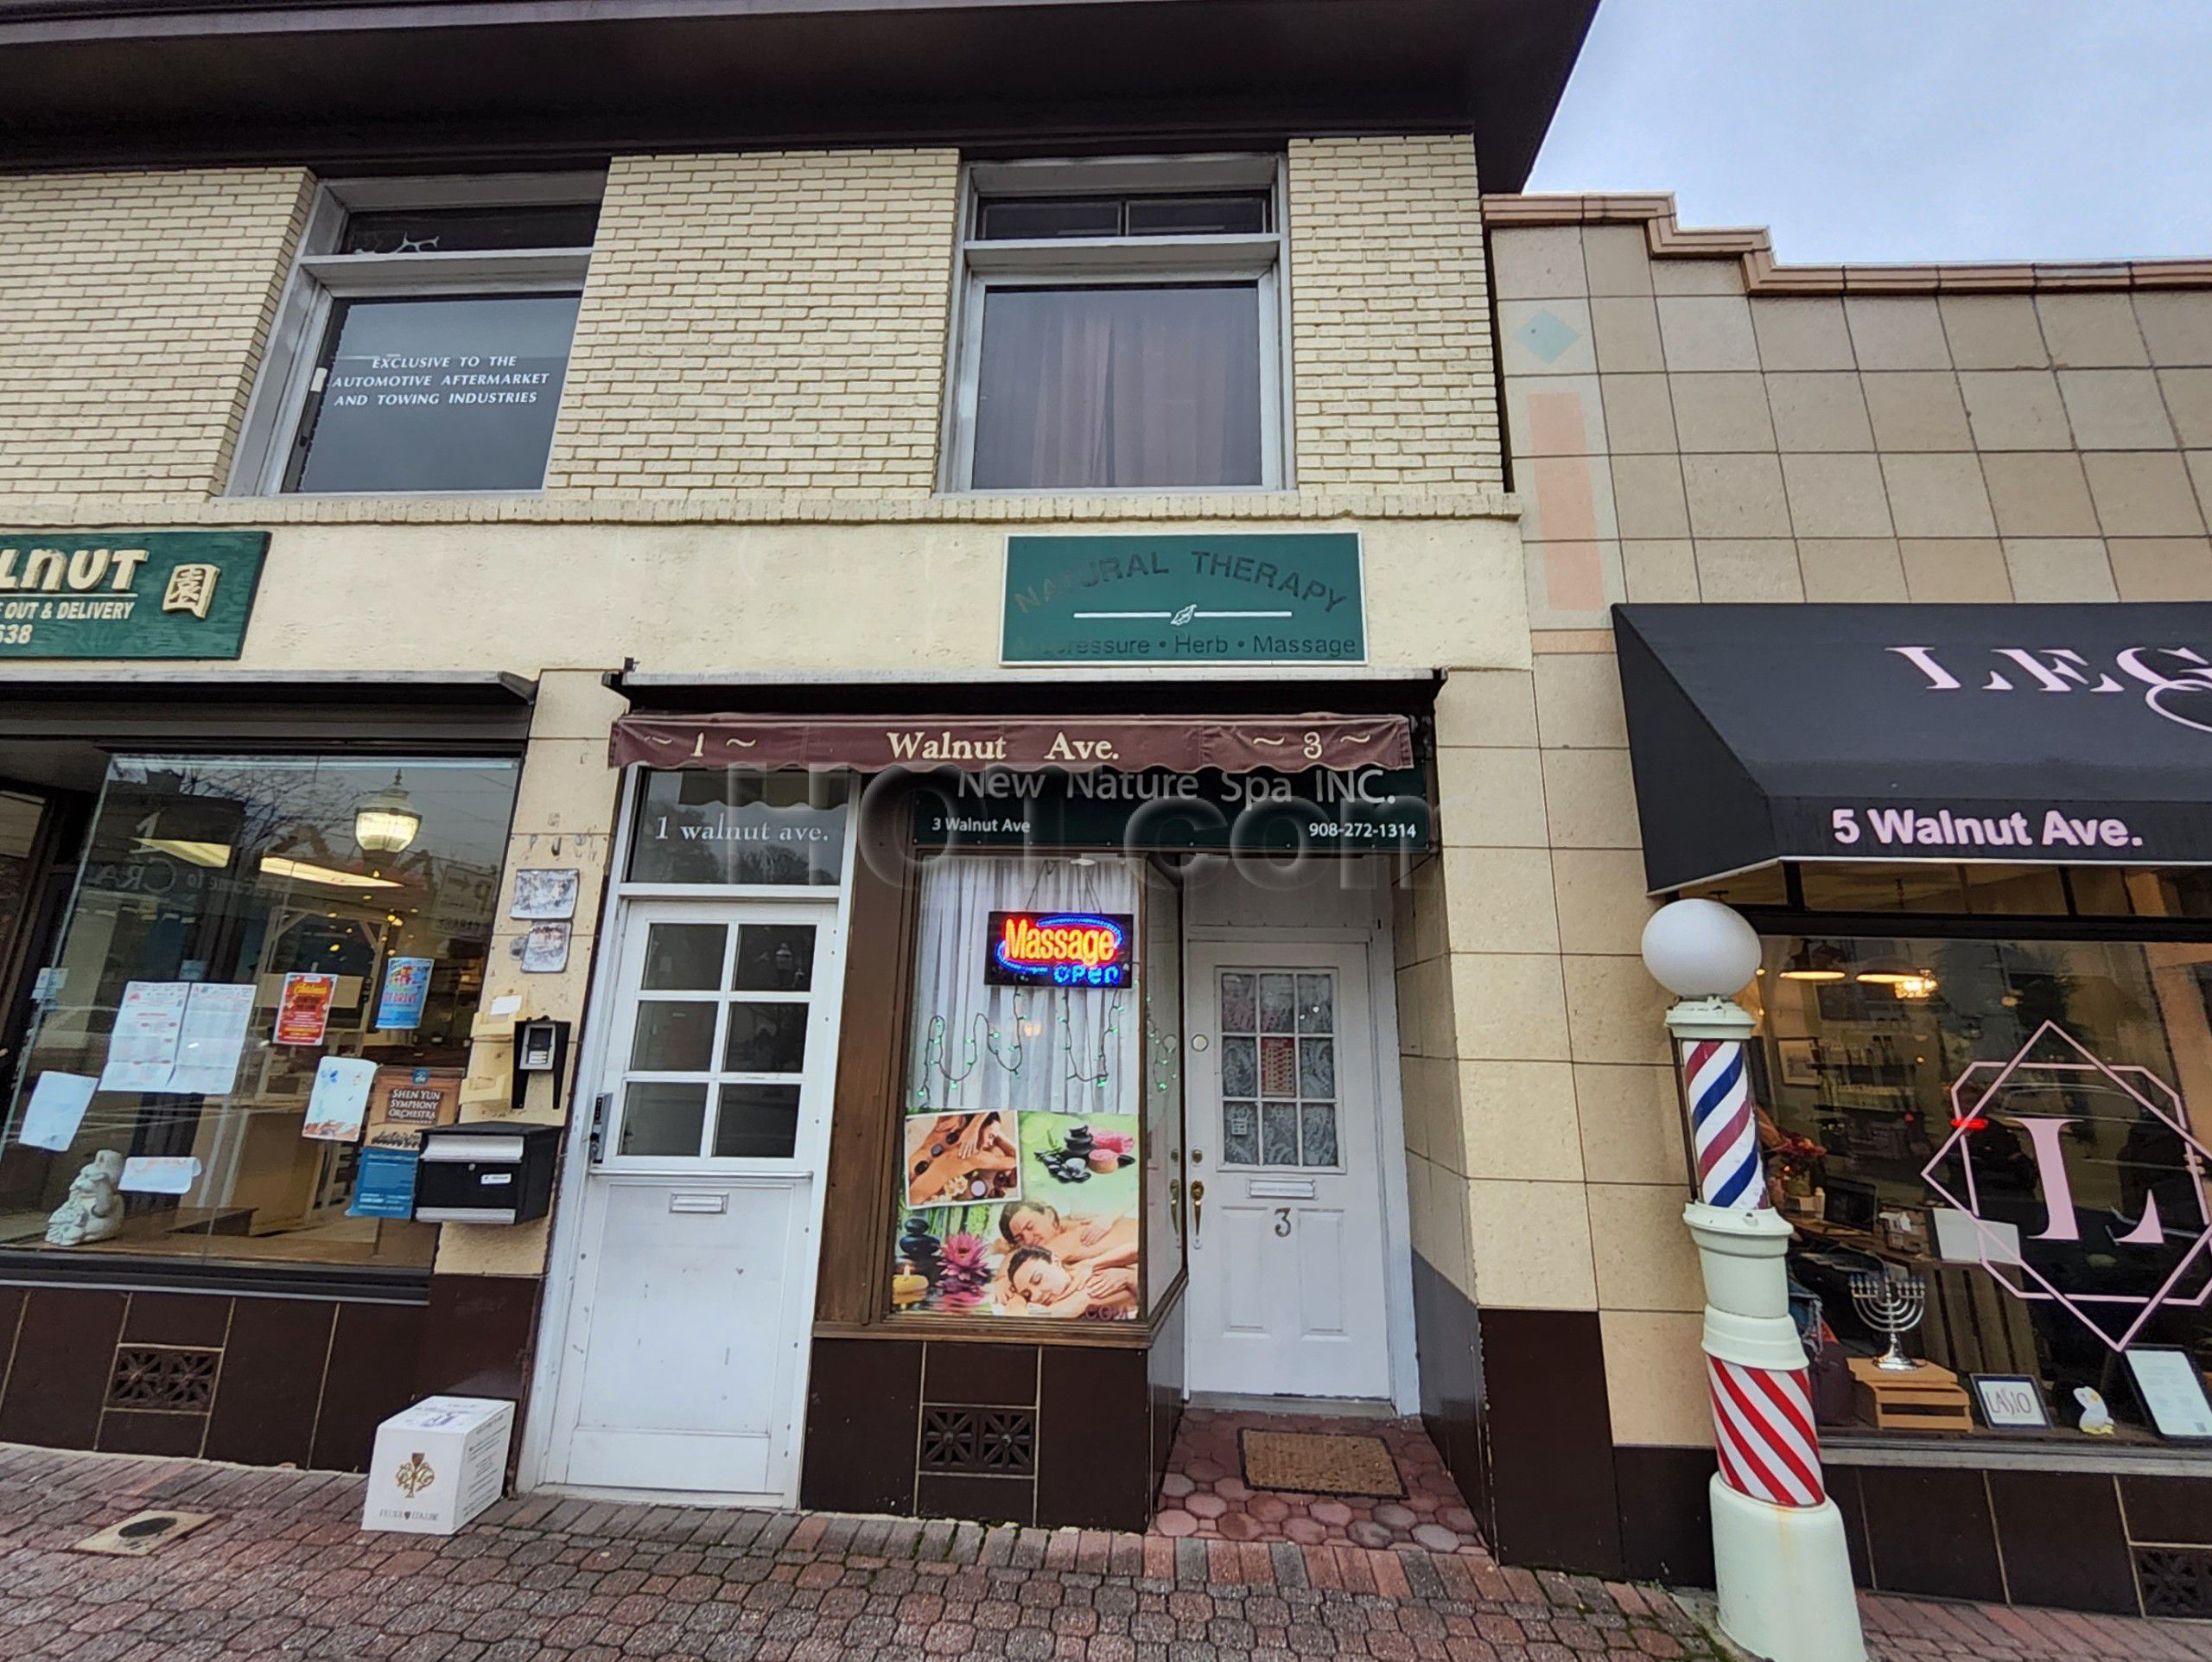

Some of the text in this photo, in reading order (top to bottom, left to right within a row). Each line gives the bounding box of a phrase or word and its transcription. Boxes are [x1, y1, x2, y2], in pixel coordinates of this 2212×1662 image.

[372, 355, 518, 369] EXCLUSIVE TO THE
[332, 373, 550, 388] AUTOMOTIVE AFTERMARKET
[334, 392, 537, 406] AND TOWING INDUSTRIES
[1192, 550, 1348, 614] THERAPY
[4, 602, 41, 620] OUT
[40, 602, 53, 620] &
[55, 602, 137, 620] DELIVERY
[0, 623, 33, 645] 38
[1174, 635, 1229, 654] Herb
[1253, 635, 1356, 659] Massage
[690, 731, 1323, 761] 1 Walnut Ave. 3
[957, 768, 1396, 810] New Nature Spa INC.
[655, 813, 830, 842] 1 walnut ave.
[932, 817, 1031, 833] 3 Walnut Ave
[1308, 823, 1417, 838] 908-272-1314
[1832, 808, 2144, 847] 5 Walnut Ave.
[1004, 918, 1115, 966] Massage
[390, 1098, 439, 1110] SYMPHONY
[391, 1088, 441, 1100] SHEN YUN
[388, 1108, 435, 1120] ORCHESTRA
[1274, 1207, 1292, 1238] 3
